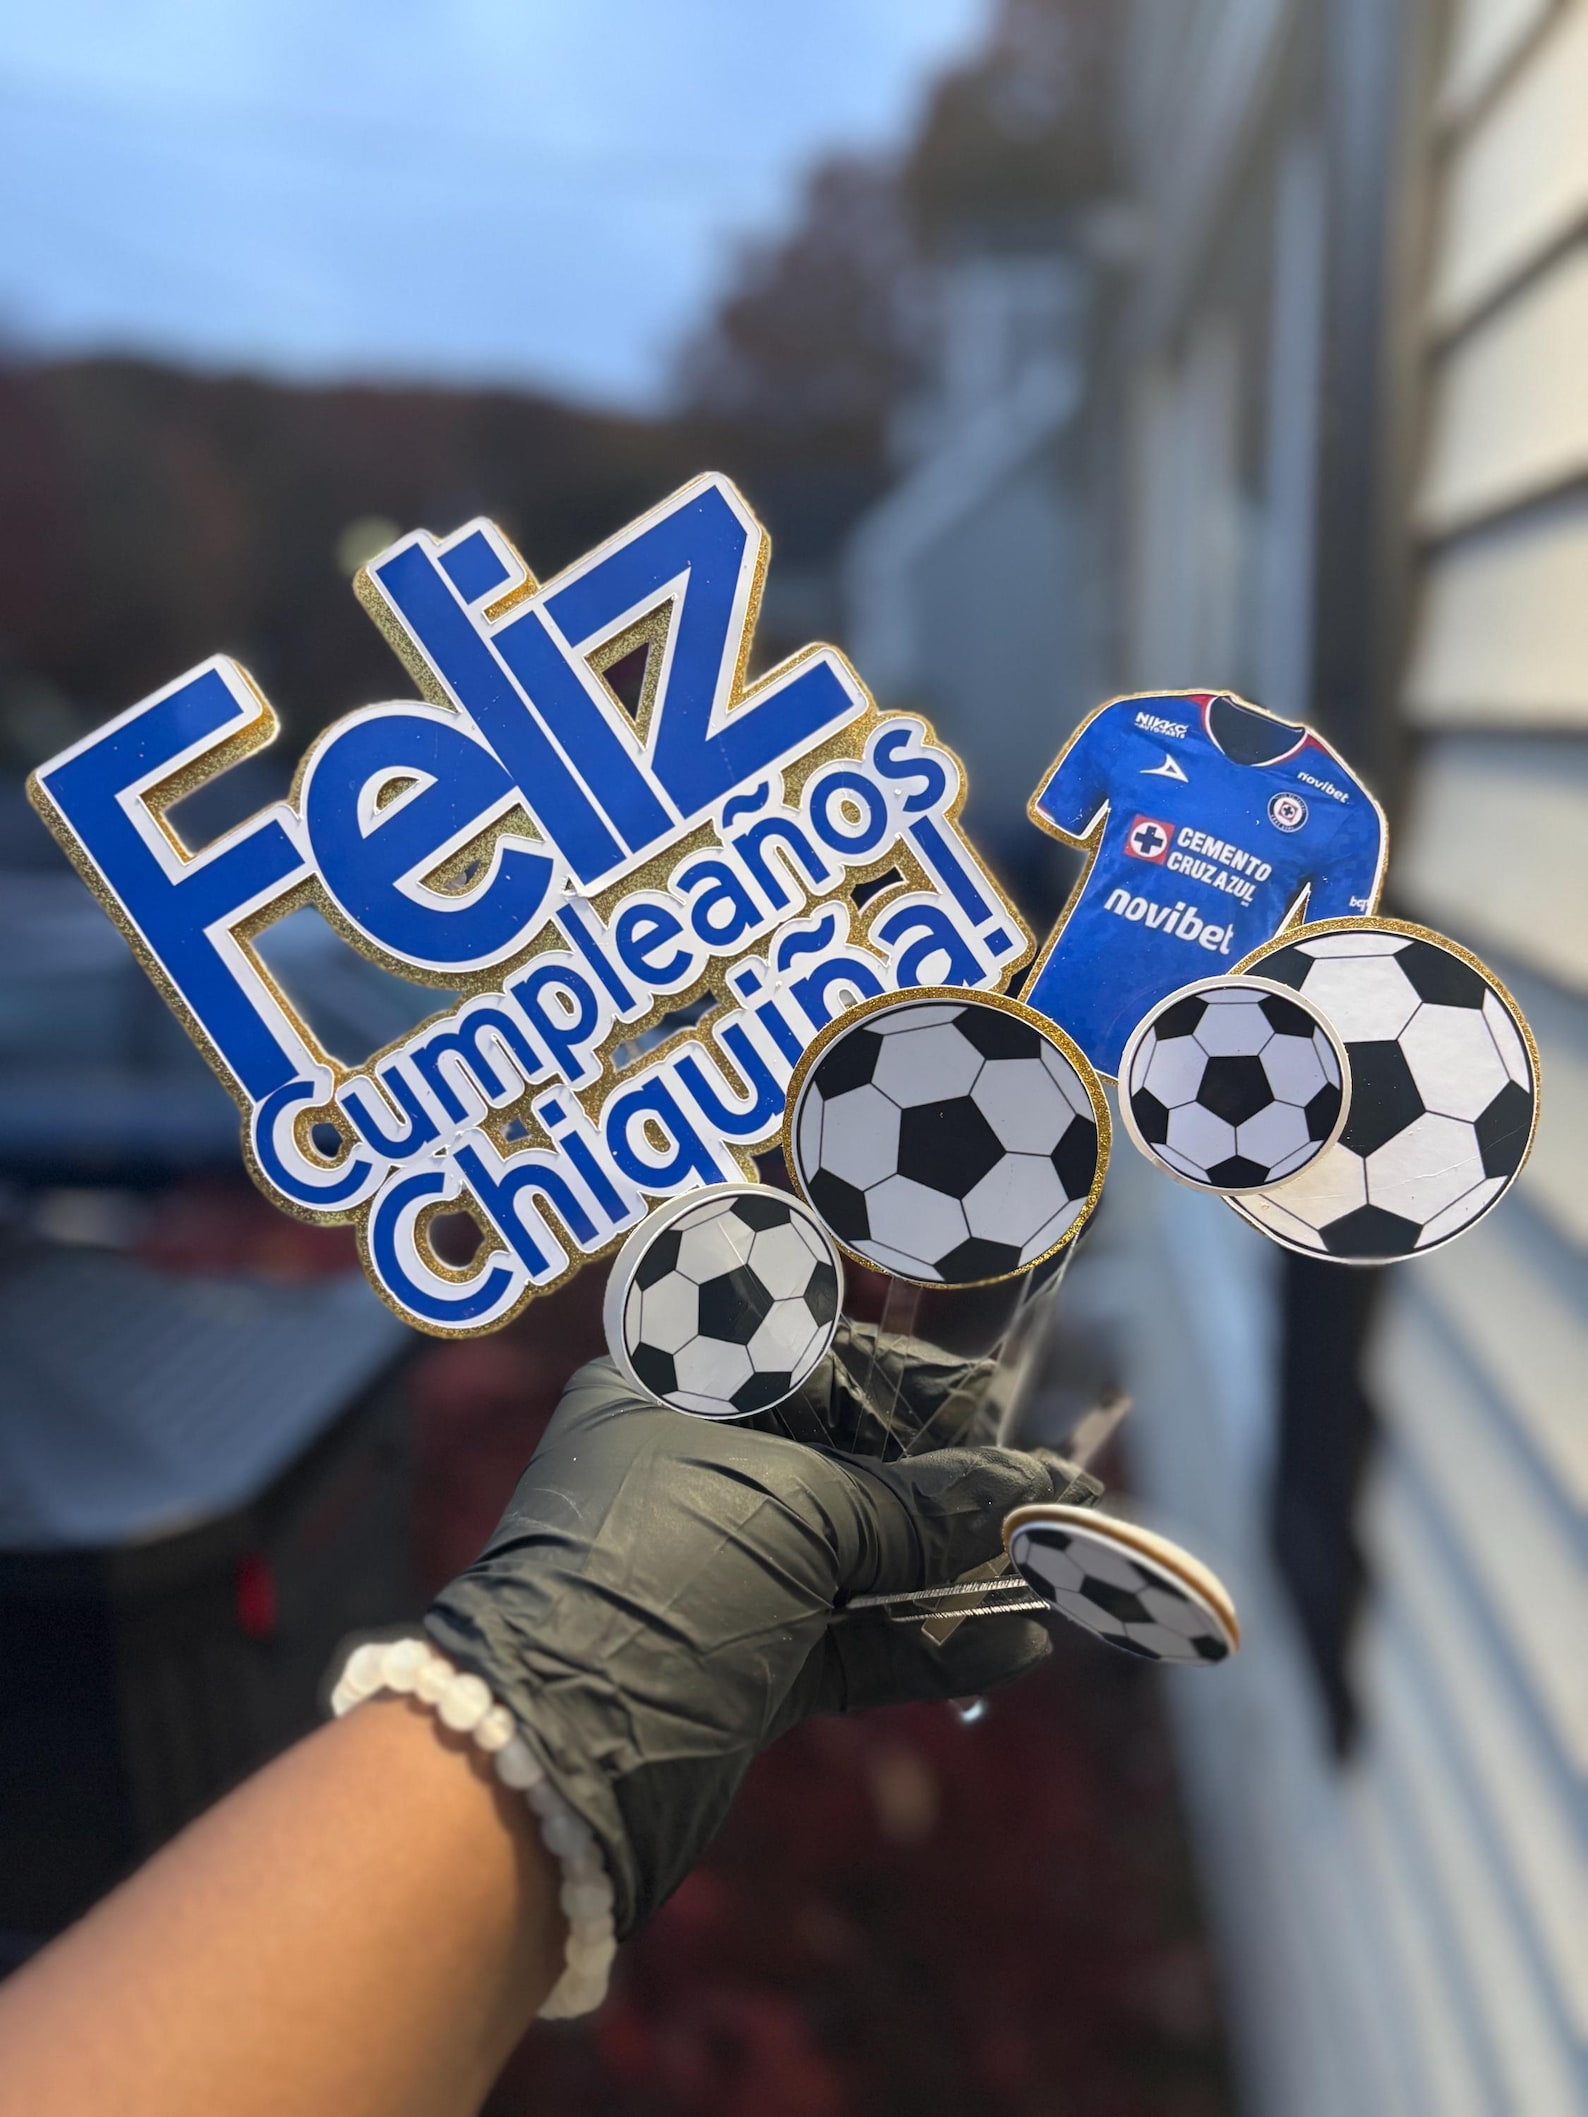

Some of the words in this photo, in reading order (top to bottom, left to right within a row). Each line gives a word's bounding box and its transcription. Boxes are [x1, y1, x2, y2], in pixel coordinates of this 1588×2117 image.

[40, 485, 856, 1101] Feliz
[1103, 888, 1235, 955] novibet
[1176, 826, 1273, 882] CEMENTO
[1296, 771, 1350, 804] novibet
[254, 728, 947, 1204] Cumpleaños
[373, 814, 1014, 1322] Chiquiña!
